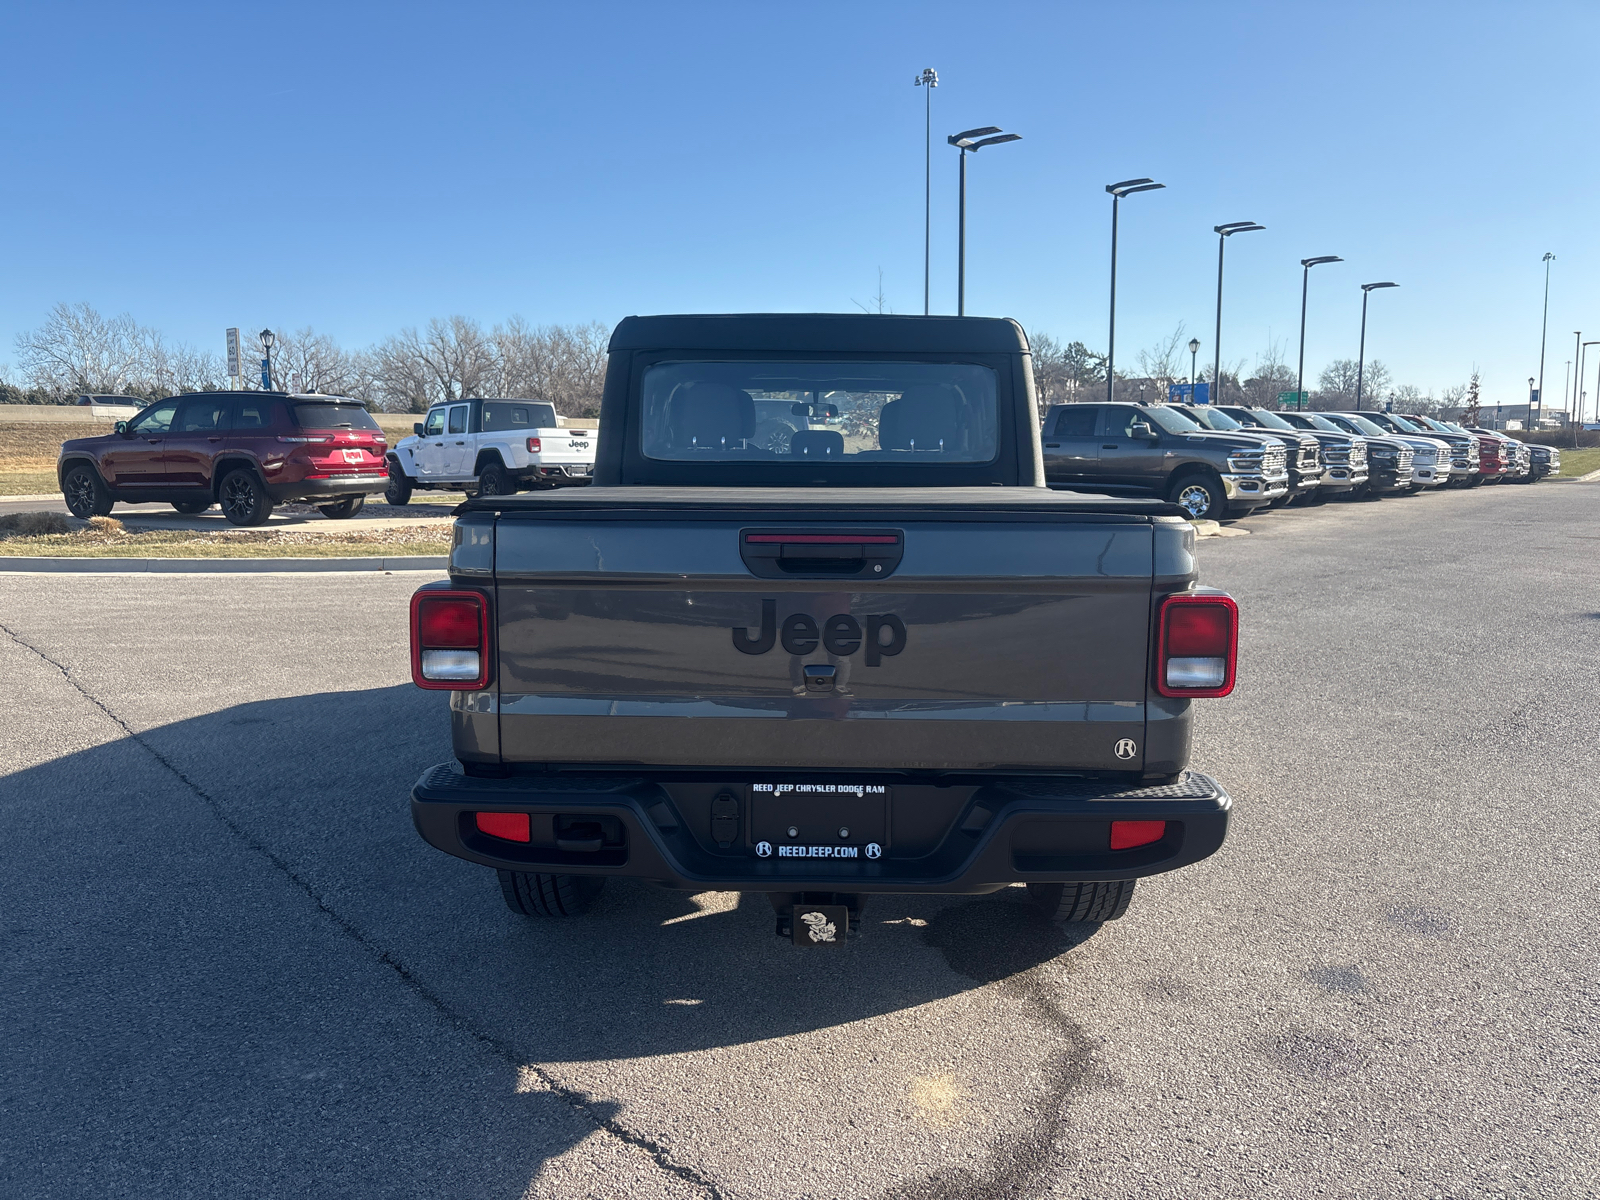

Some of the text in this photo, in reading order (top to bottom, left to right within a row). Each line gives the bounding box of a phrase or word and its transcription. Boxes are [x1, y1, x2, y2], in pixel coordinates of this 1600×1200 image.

[228, 346, 236, 356] 60
[568, 439, 589, 449] Jeep
[732, 599, 907, 667] Jeep
[753, 783, 885, 793] REED JEEP CHRYSLER DODGE RAM
[778, 846, 858, 858] REEDJEEP.COM
